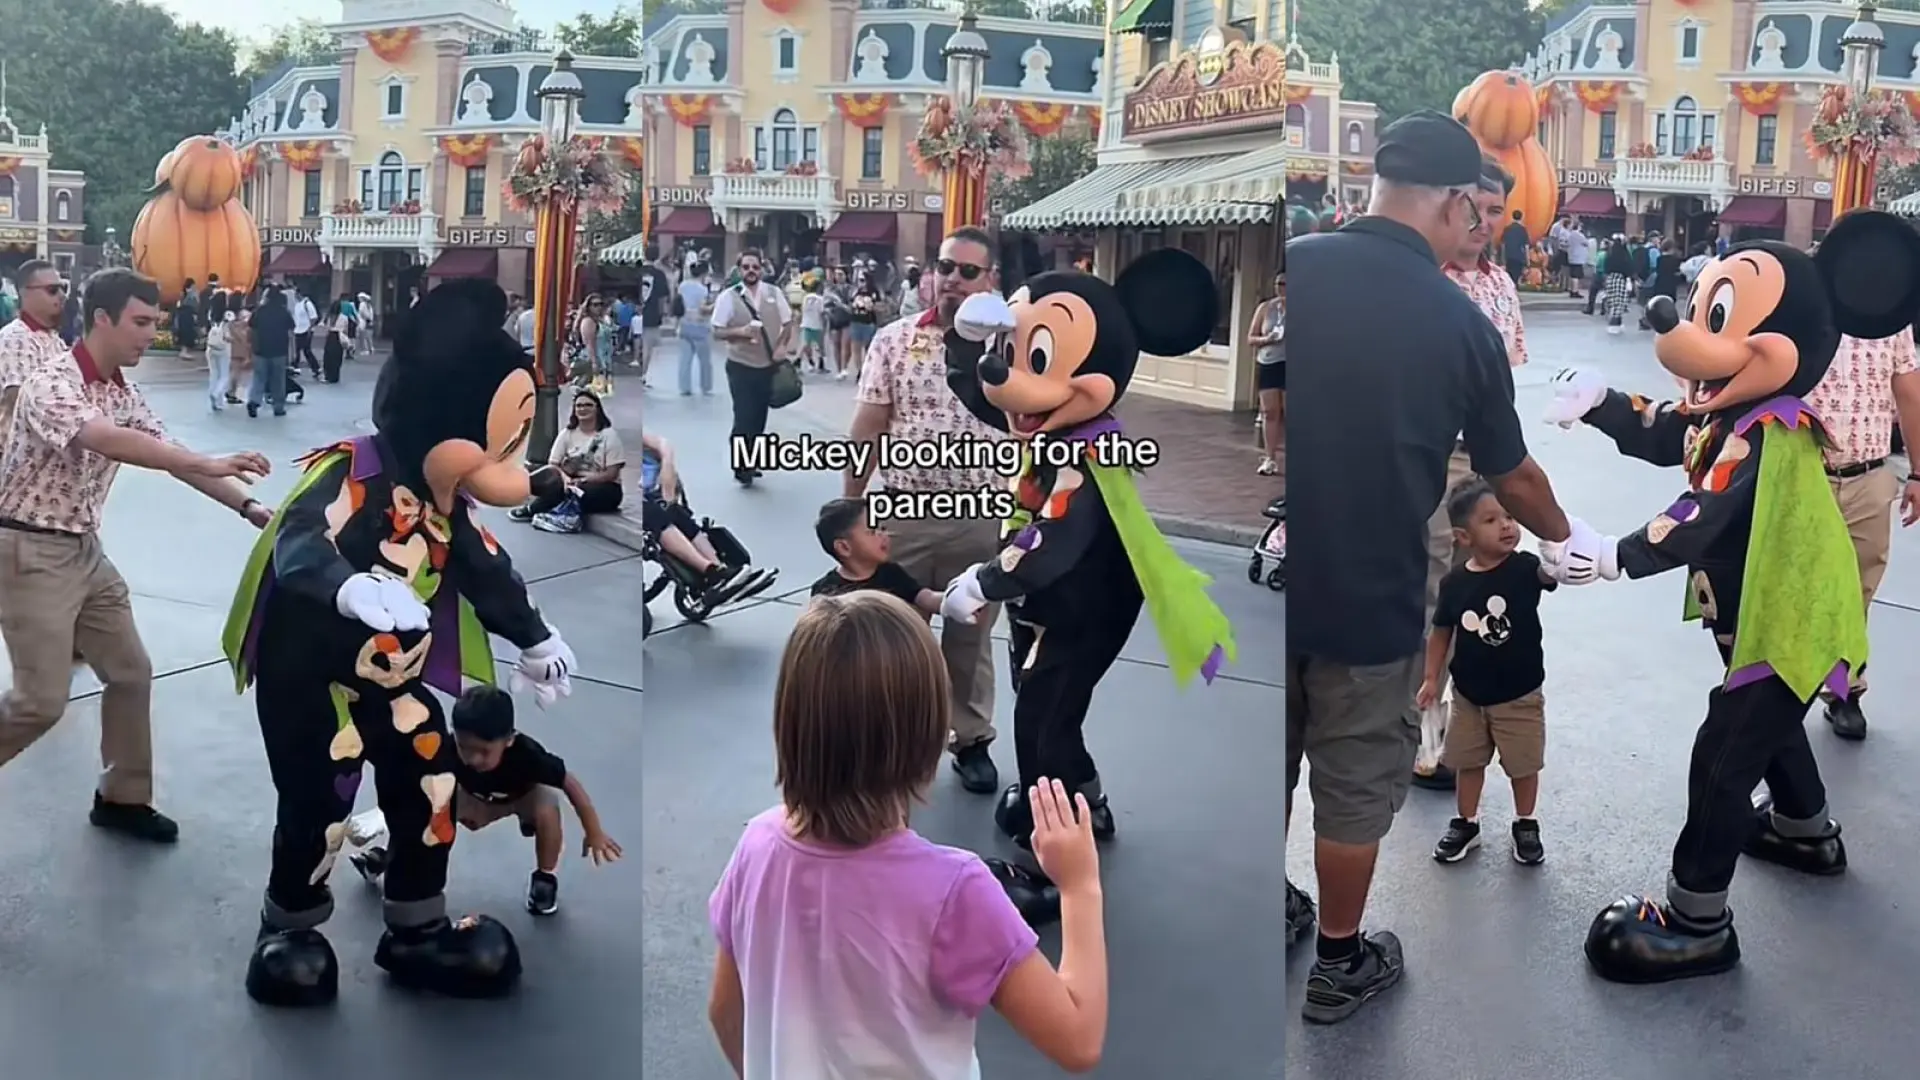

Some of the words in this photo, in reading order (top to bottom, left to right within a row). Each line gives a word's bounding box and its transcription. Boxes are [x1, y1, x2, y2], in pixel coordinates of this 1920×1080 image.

[1134, 99, 1188, 128] DISNEY
[1740, 179, 1797, 195] GIFTS
[848, 192, 907, 209] GIFTS
[450, 229, 507, 245] GIFTS
